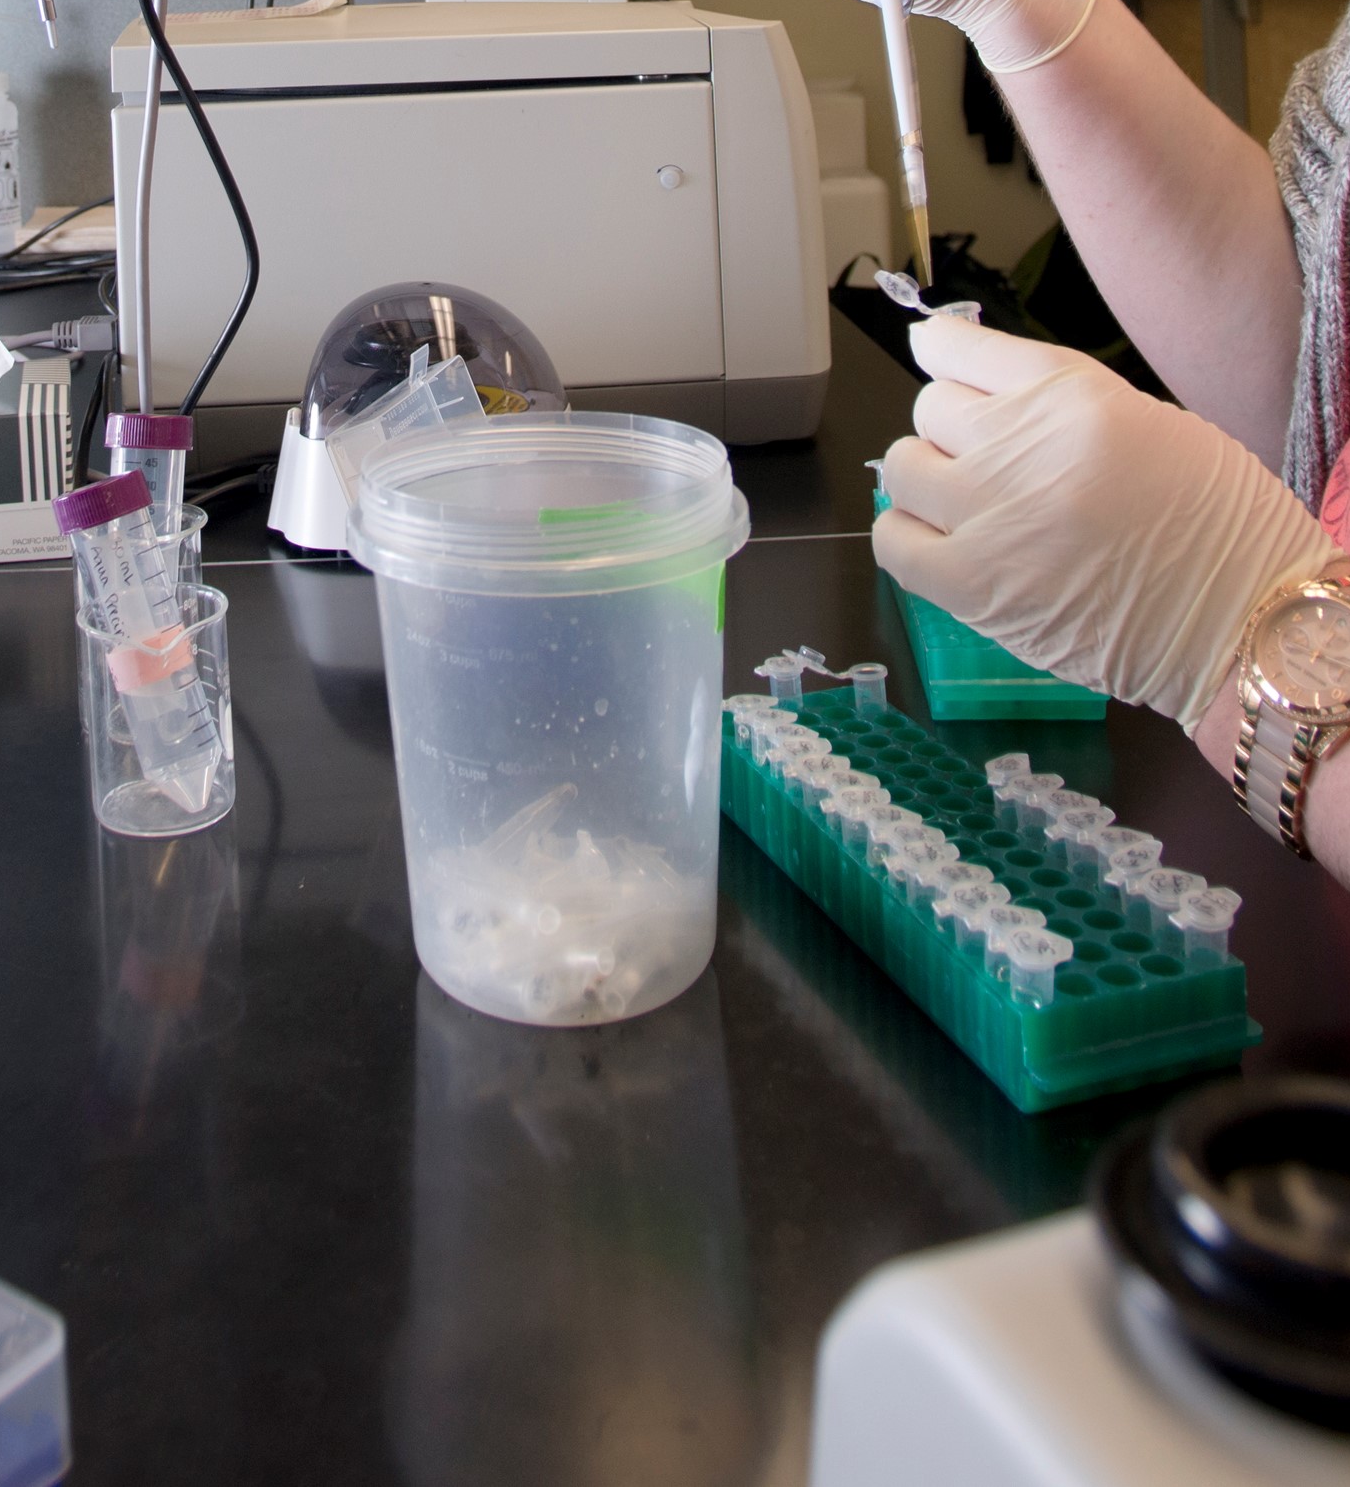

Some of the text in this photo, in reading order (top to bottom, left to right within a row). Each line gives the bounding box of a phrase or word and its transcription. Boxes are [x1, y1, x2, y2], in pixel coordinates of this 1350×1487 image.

[145, 457, 159, 468] 45
[12, 534, 68, 546] PACIFIC PAPER
[32, 545, 45, 554] WA
